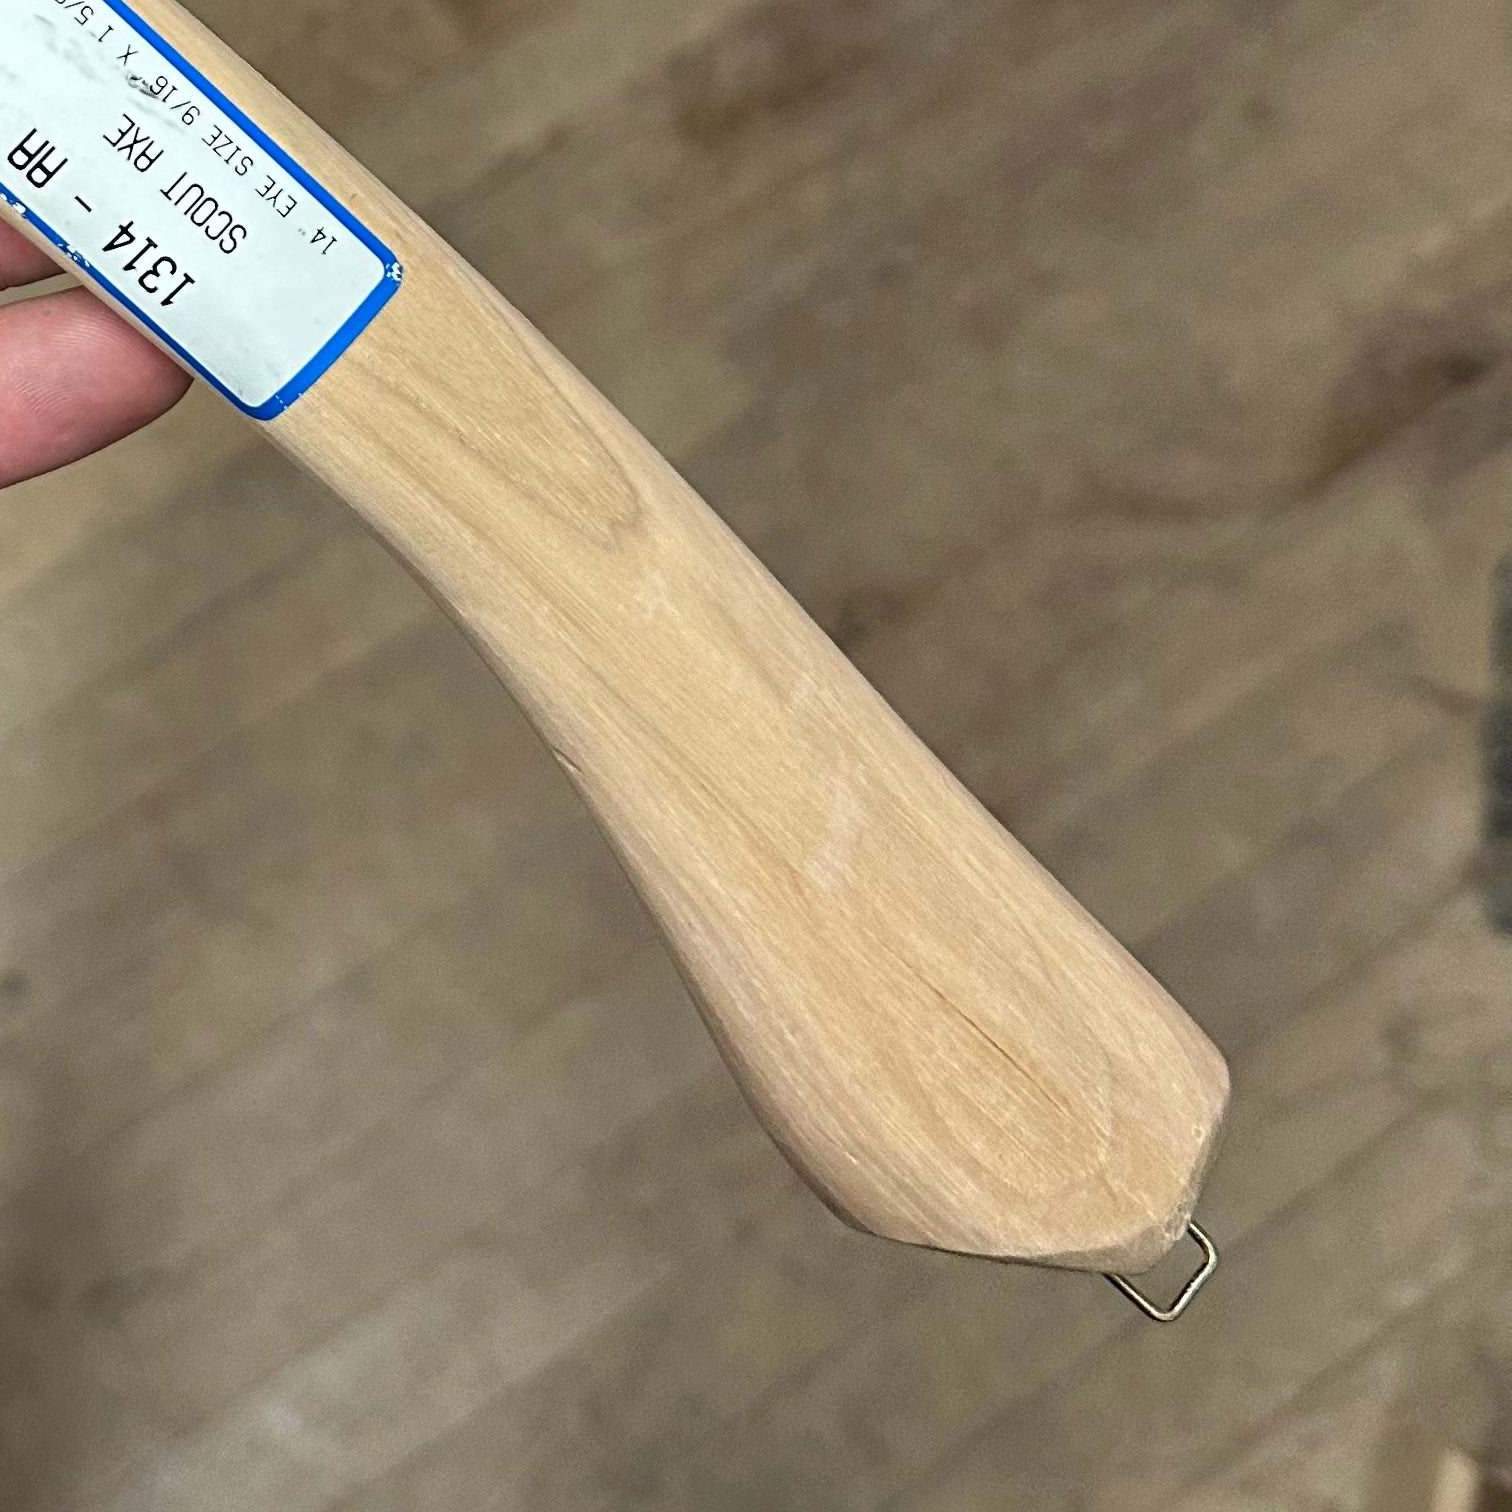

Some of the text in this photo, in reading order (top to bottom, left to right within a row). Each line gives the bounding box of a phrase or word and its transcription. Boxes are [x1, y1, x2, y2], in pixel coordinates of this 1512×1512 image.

[98, 24, 115, 43] 1
[116, 44, 139, 67] X
[201, 124, 254, 176] SIZE
[102, 113, 248, 255] SCOUT AXE
[254, 174, 298, 218] EYE
[6, 127, 196, 307] 1314 - AA
